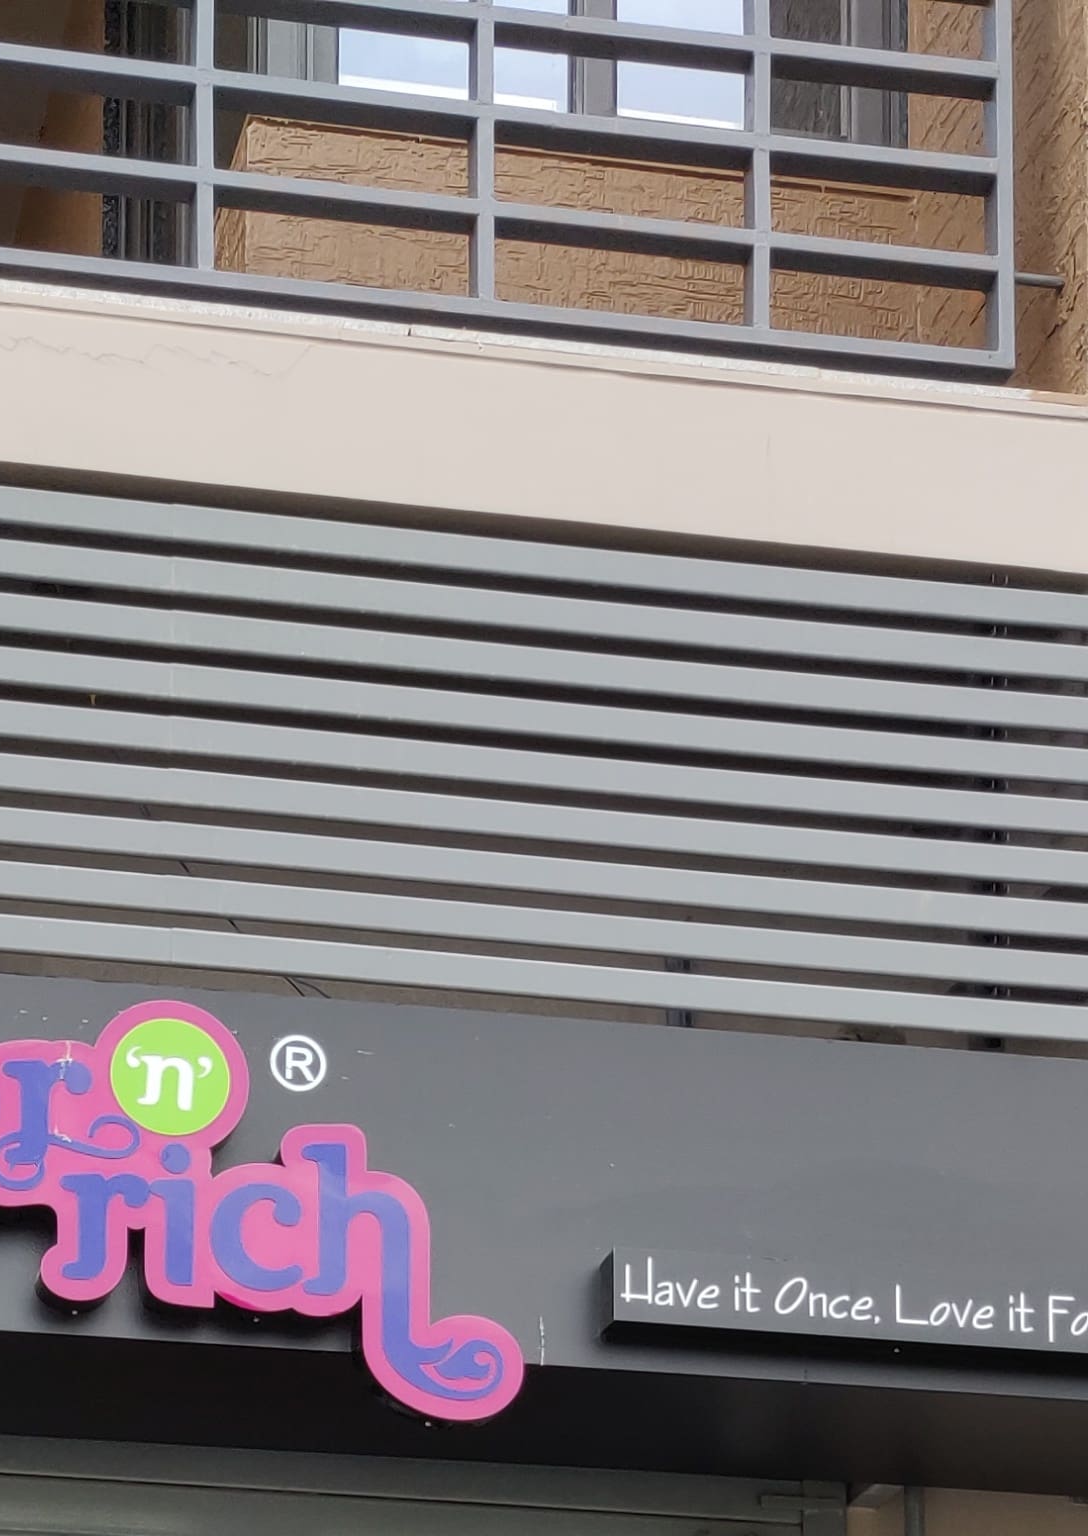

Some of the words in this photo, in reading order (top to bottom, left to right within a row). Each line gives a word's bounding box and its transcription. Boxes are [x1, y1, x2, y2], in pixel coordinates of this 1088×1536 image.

[61, 1142, 504, 1401] rich
[620, 1256, 720, 1309] Have
[733, 1272, 762, 1314] it
[774, 1277, 881, 1324] Once,
[895, 1284, 995, 1330] Love
[1008, 1291, 1035, 1333] it
